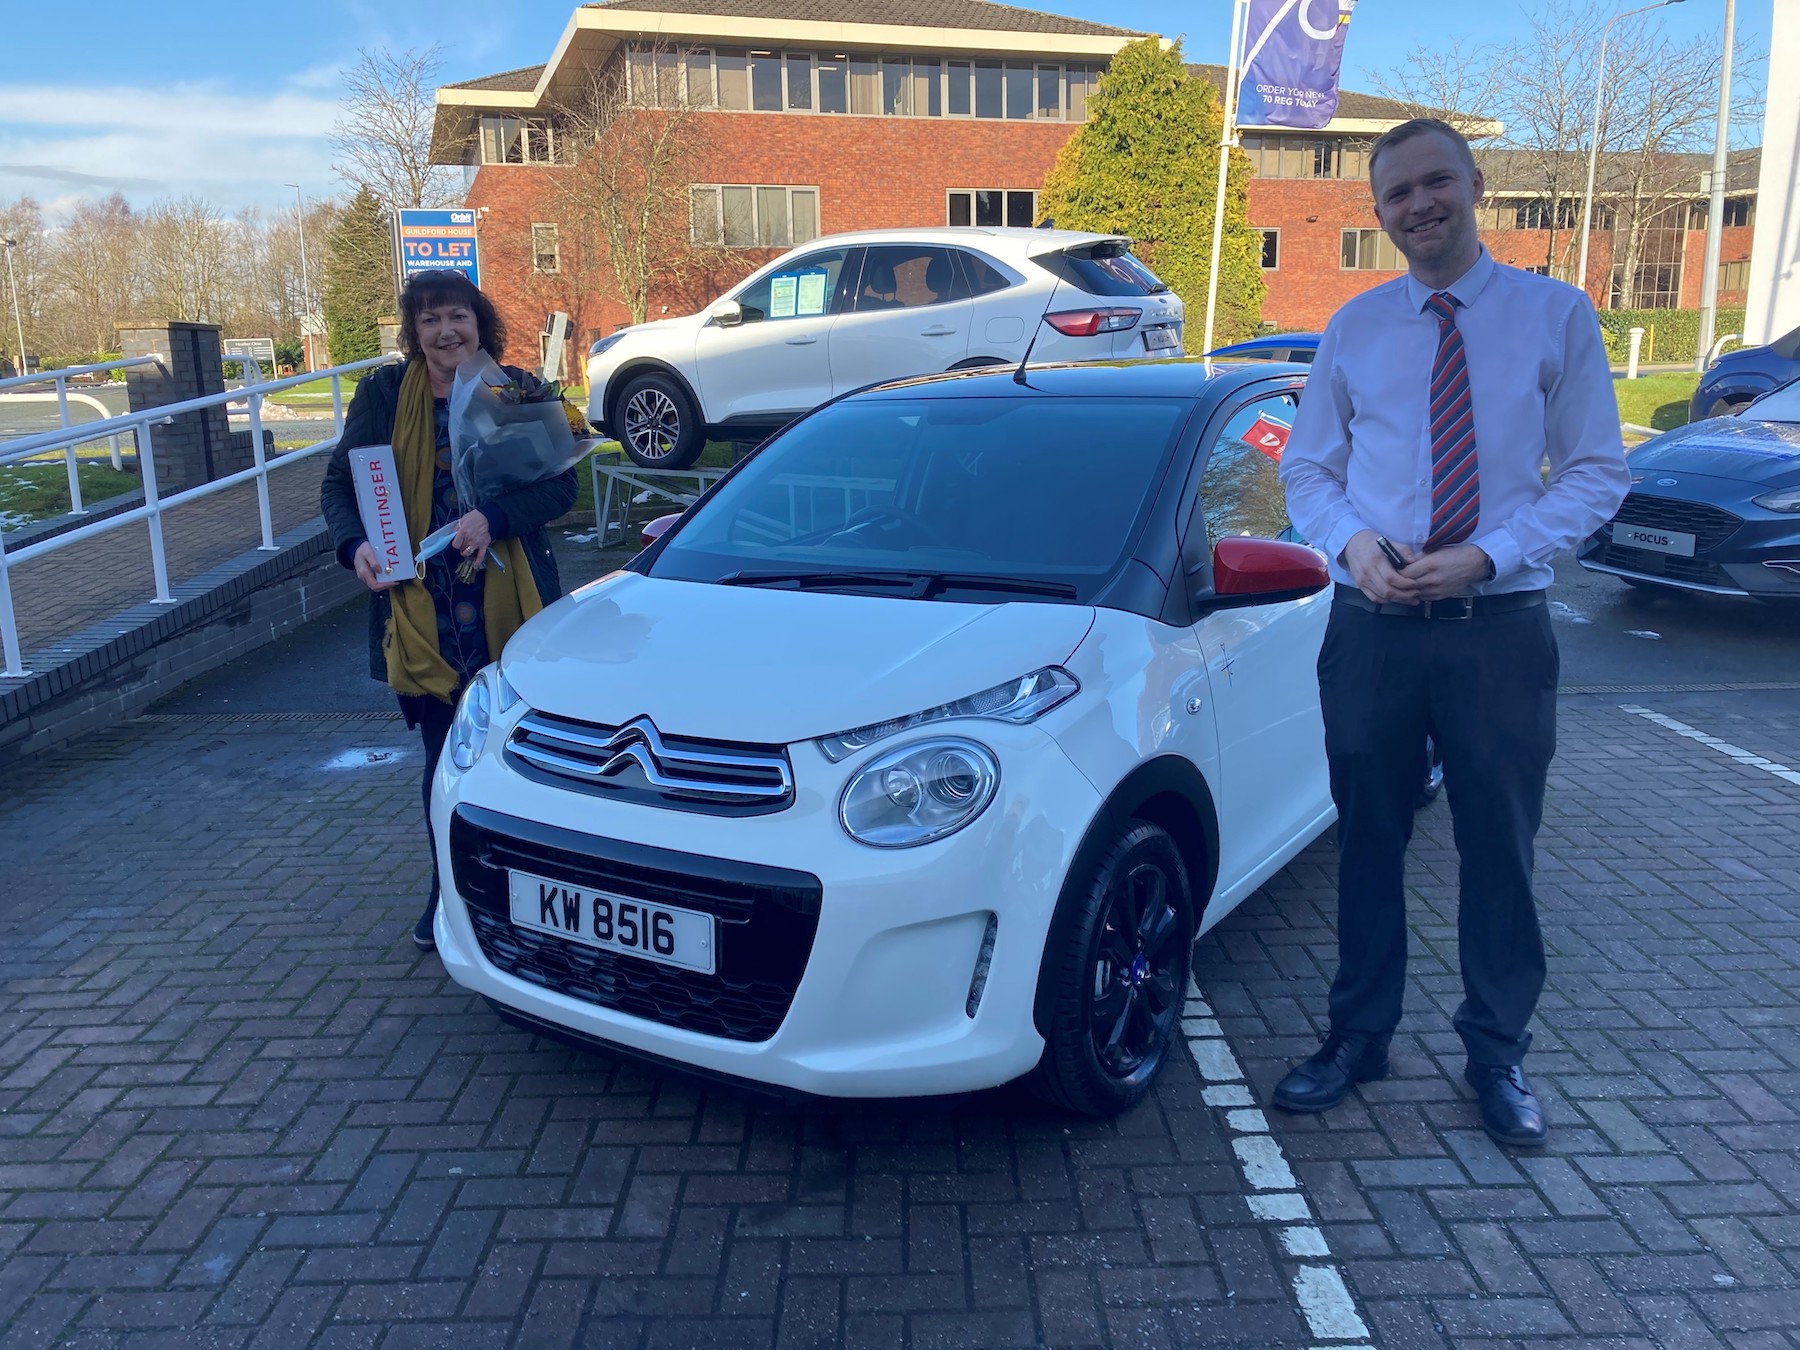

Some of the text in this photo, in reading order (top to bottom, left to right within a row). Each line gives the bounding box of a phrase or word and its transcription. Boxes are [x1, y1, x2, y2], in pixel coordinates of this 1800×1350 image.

[1256, 84, 1286, 95] ORDER
[1262, 94, 1273, 104] 70
[1274, 96, 1293, 106] REG
[405, 242, 472, 257] TO LET
[369, 460, 400, 568] TAITTINGER
[1633, 531, 1669, 546] FOCUS
[539, 883, 675, 956] KW 8516
